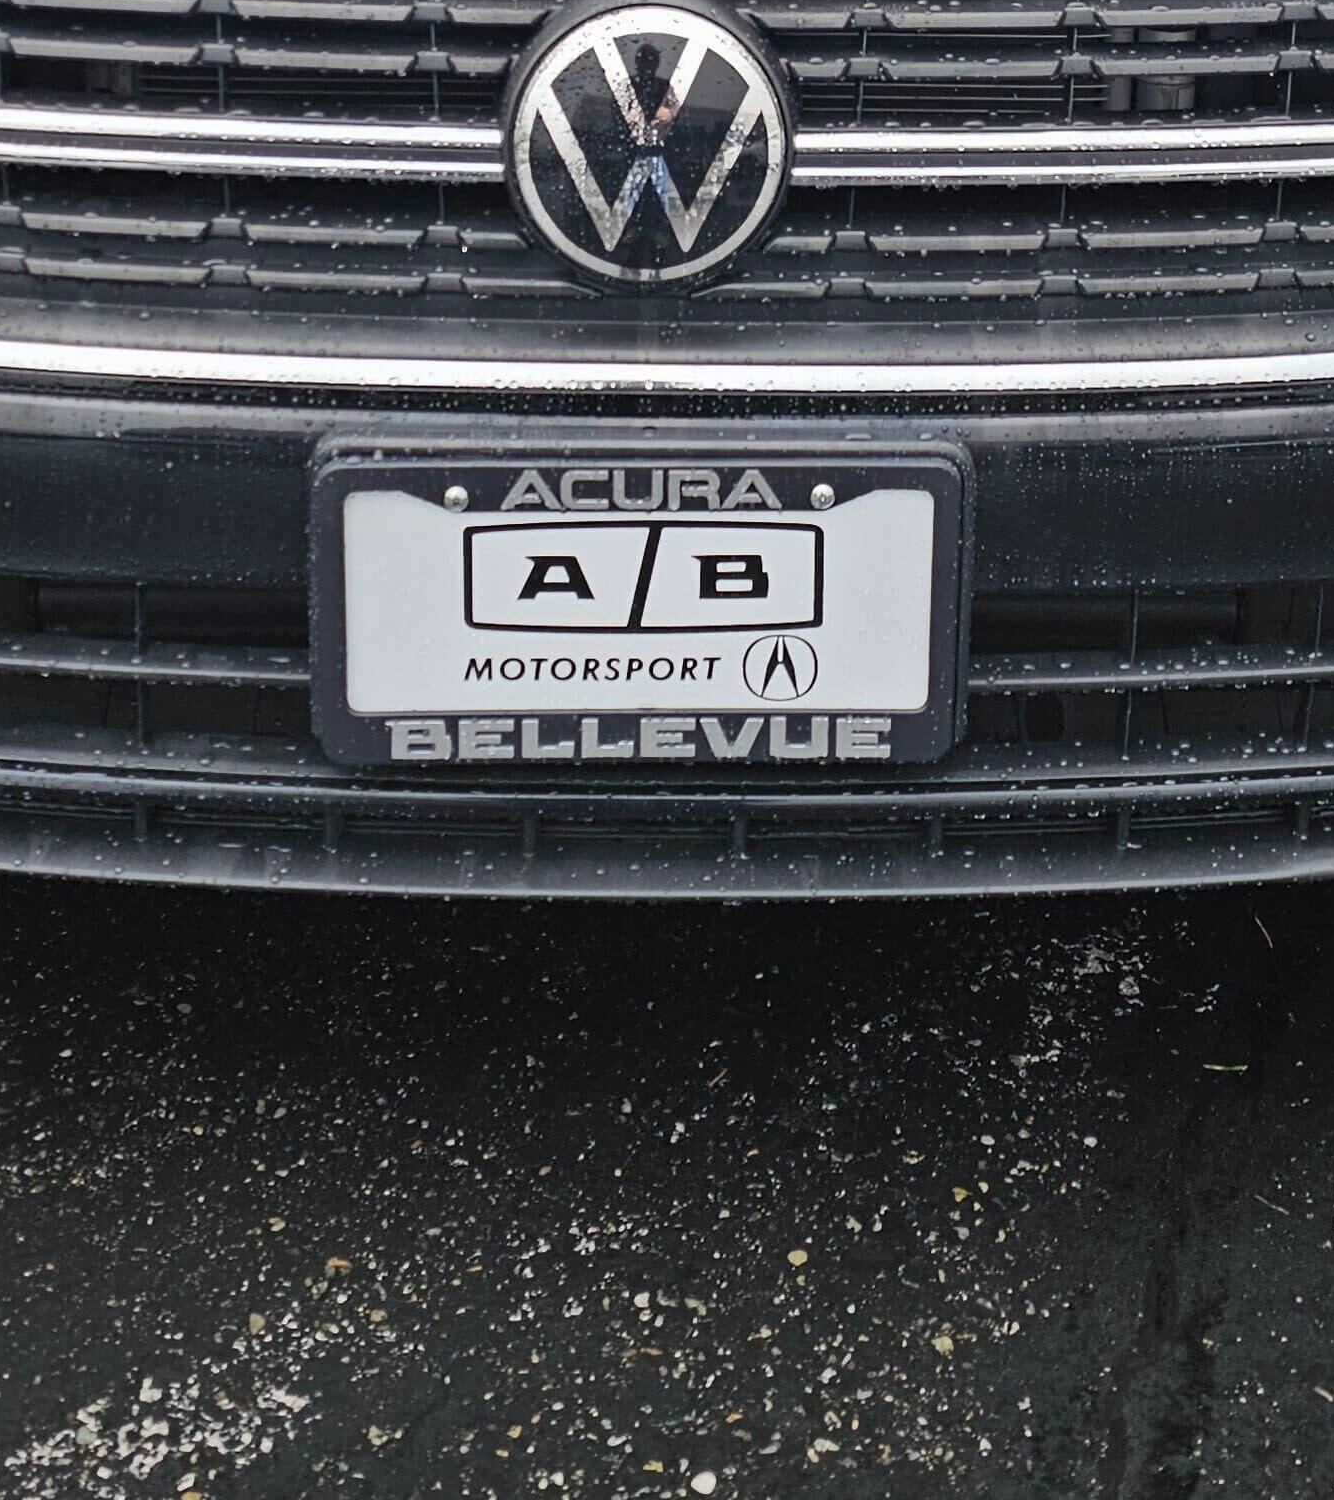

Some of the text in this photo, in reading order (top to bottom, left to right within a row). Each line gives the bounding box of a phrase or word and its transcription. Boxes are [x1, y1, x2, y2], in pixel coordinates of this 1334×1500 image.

[500, 468, 782, 511] ACURA
[464, 656, 722, 683] MOTORSPORT
[387, 716, 892, 760] BELLEVUE
